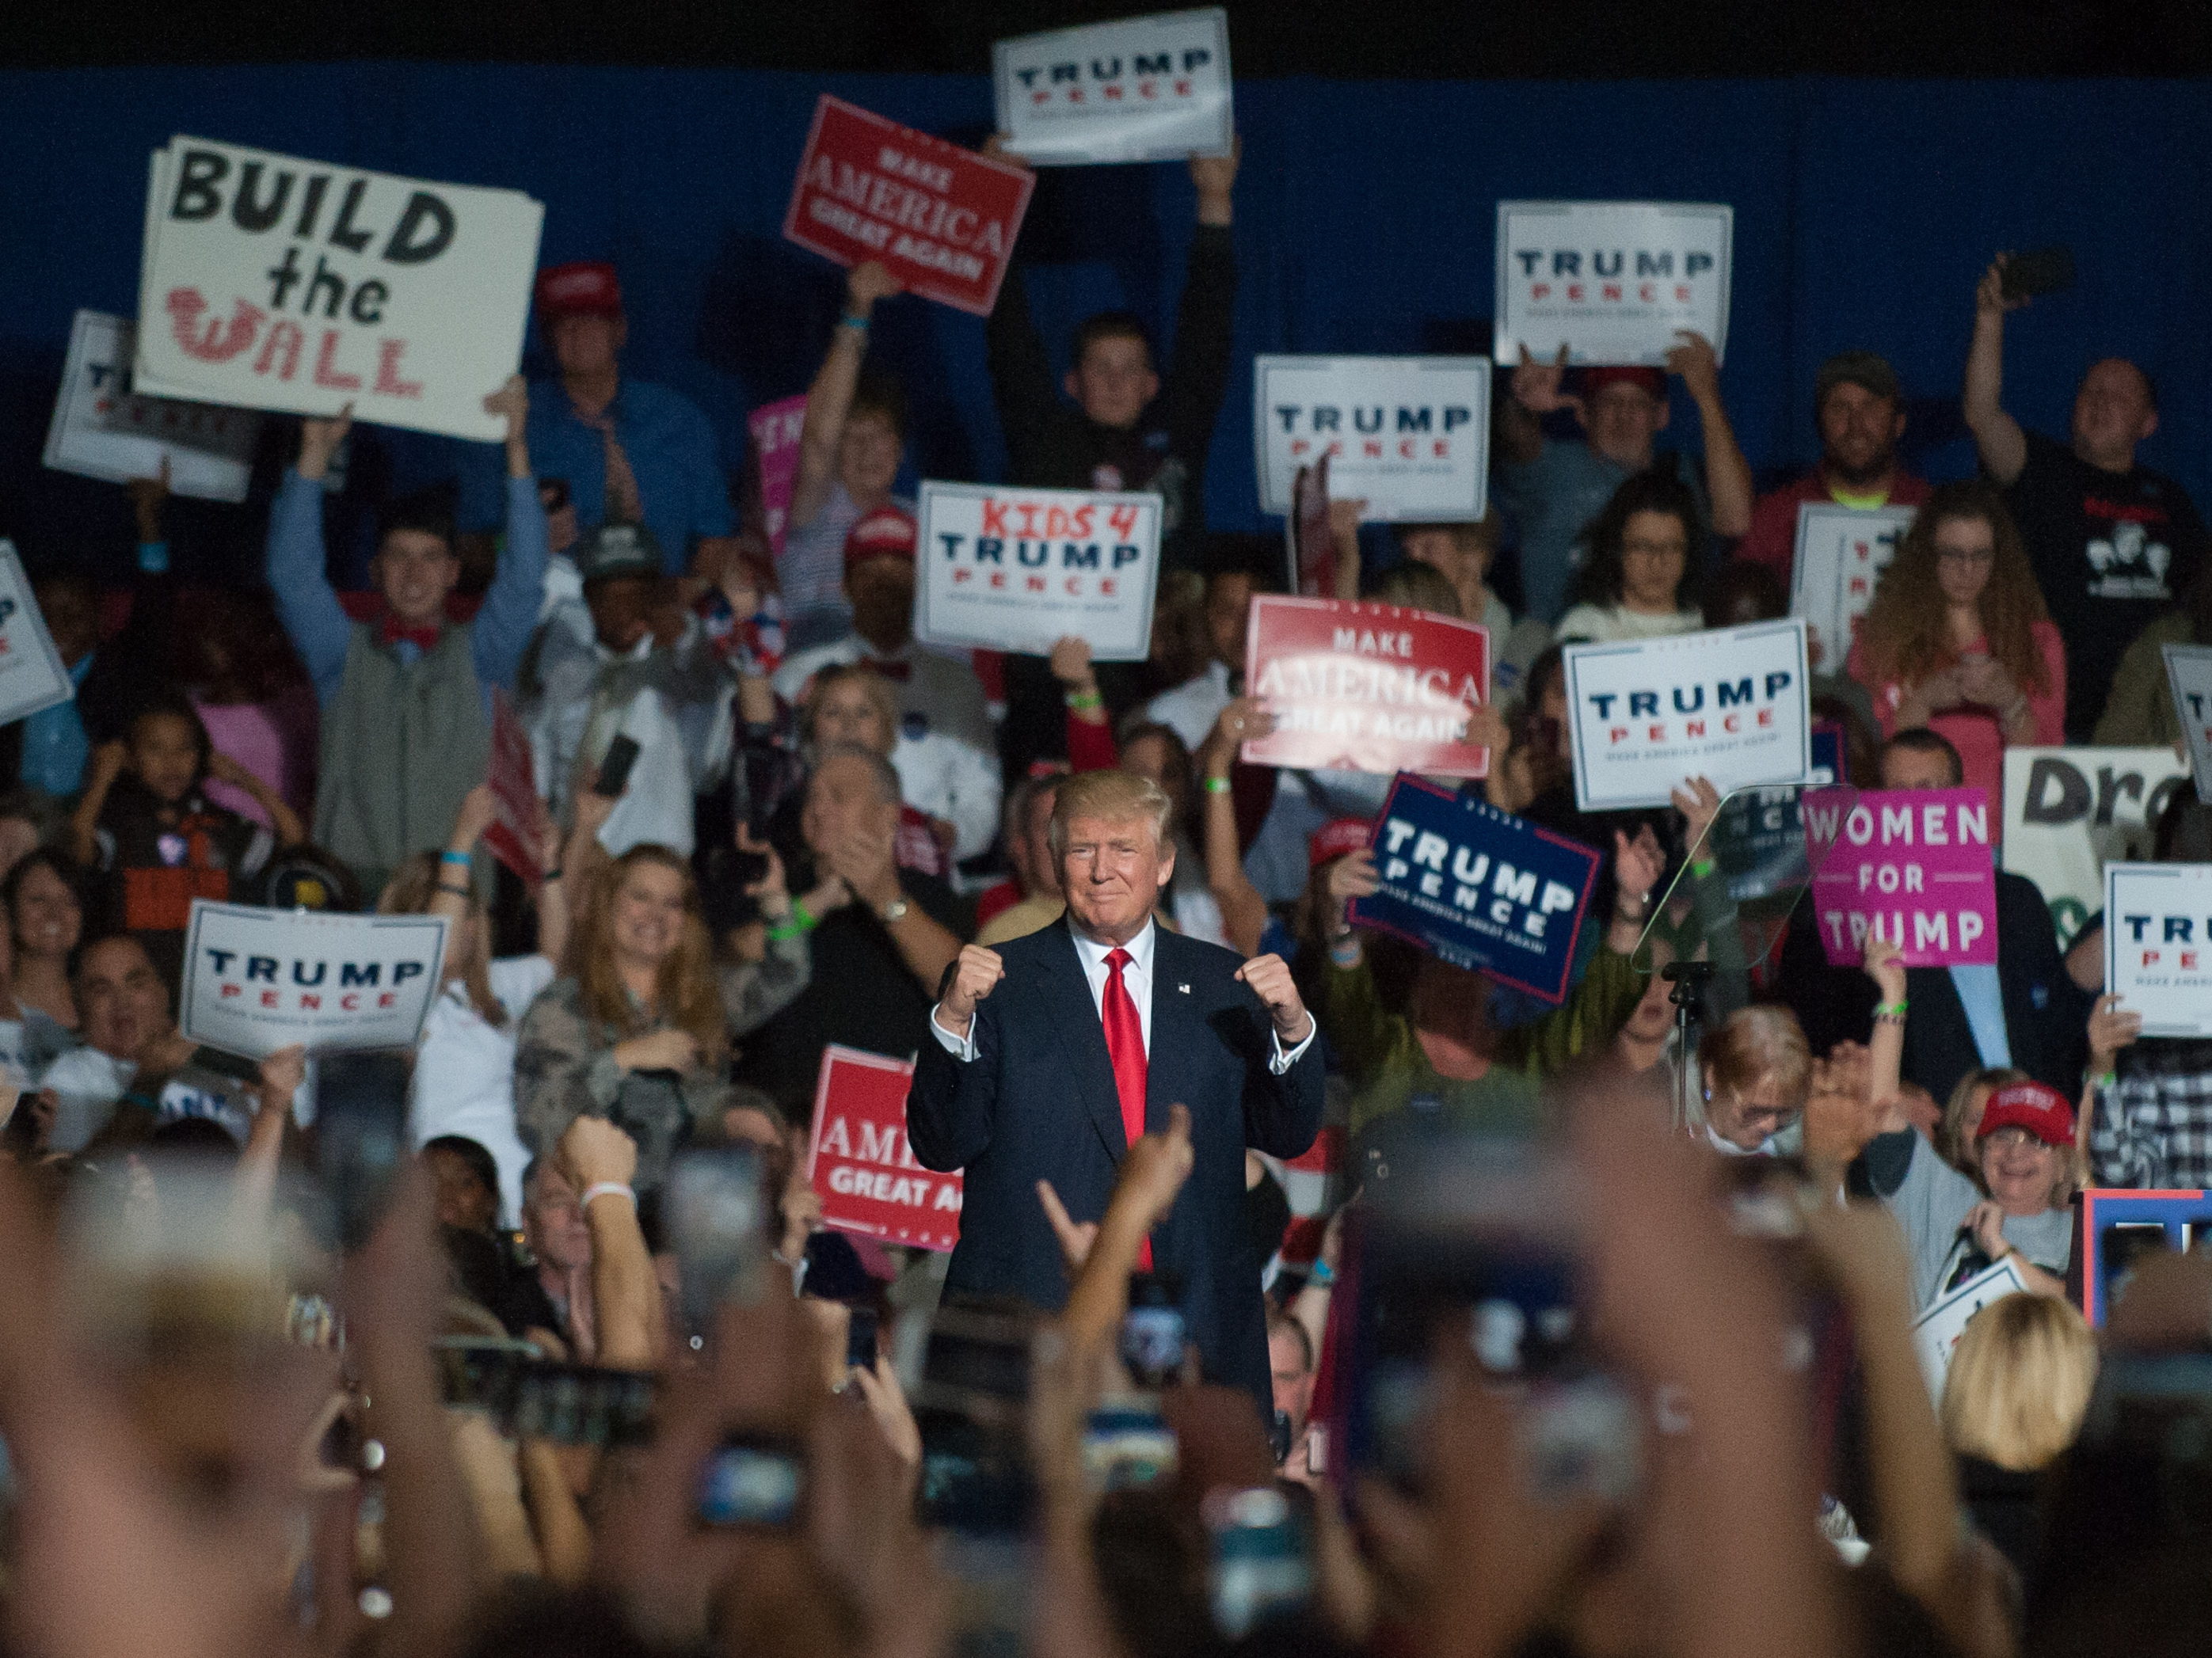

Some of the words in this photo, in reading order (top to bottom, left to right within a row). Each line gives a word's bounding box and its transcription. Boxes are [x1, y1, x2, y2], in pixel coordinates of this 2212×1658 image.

[1016, 48, 1212, 87] TRUMP
[167, 150, 458, 266] BUILD
[806, 154, 1005, 256] AMERICA
[1516, 249, 1713, 279] TRUMP
[267, 246, 390, 326] the
[1531, 282, 1692, 303] PENCE
[166, 286, 424, 399] WALL
[1274, 404, 1472, 434] TRUMP
[980, 497, 1096, 540] KIDS
[1108, 504, 1138, 540] 4
[938, 531, 1140, 571] TRUMP
[954, 568, 1118, 596] PENCE
[1332, 628, 1414, 658] MAKE
[1255, 658, 1482, 706] AMERICA
[1589, 671, 1792, 721] TRUMP
[1609, 707, 1774, 744] PENCE
[1806, 803, 1989, 845] WOMEN
[1385, 815, 1575, 915] TRUMP
[1857, 864, 1924, 893] FOR
[1384, 856, 1548, 938] PENCE
[1824, 910, 1985, 953] TRUMP
[2124, 915, 2212, 944] TR
[205, 947, 425, 988] TRUMP
[219, 982, 396, 1011] PENCE
[828, 1165, 931, 1207] GREAT
[934, 1185, 963, 1212] A
